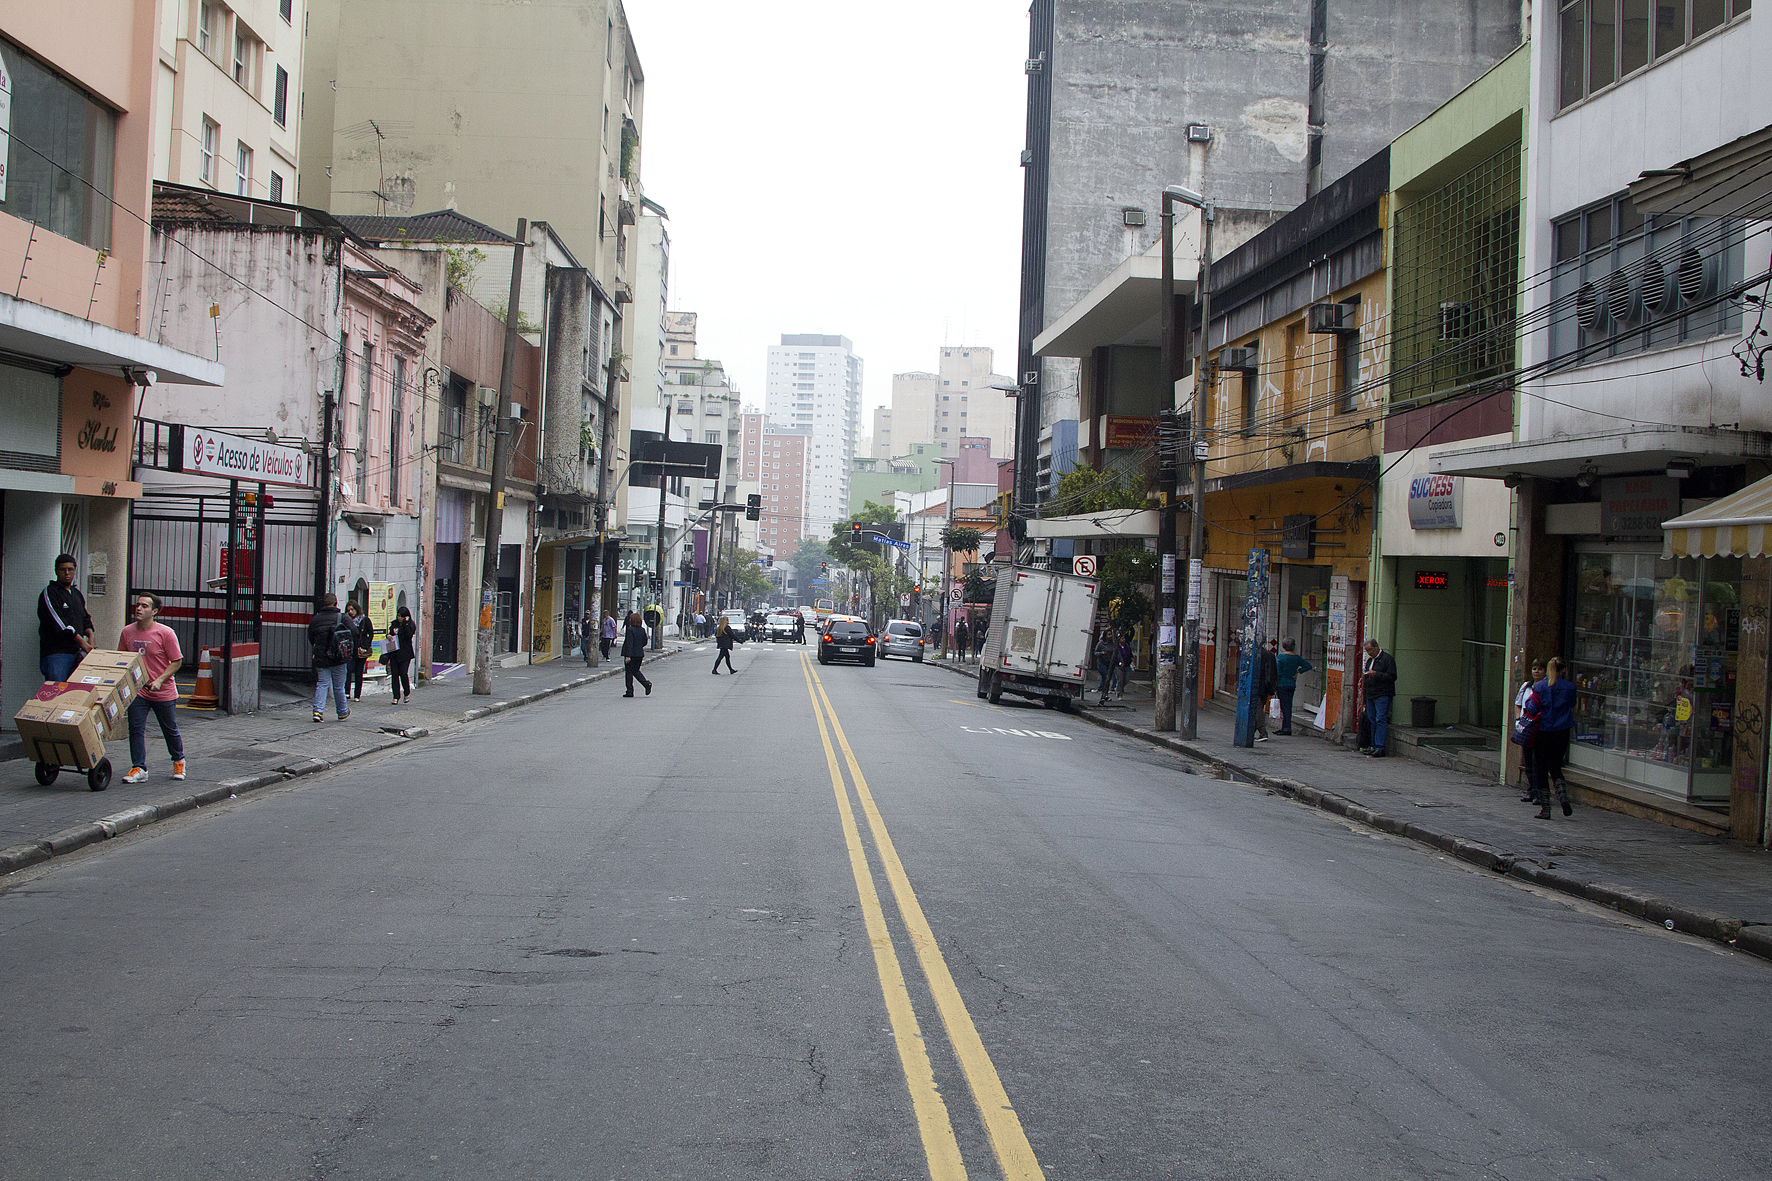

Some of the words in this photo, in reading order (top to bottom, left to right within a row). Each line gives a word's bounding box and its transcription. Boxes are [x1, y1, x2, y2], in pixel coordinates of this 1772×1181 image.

[216, 441, 248, 471] Acesso
[249, 446, 261, 472] de
[262, 449, 293, 477] Veículos
[1410, 475, 1455, 499] SUCCESS
[1428, 498, 1453, 513] Copiadora
[1609, 497, 1669, 513] PAPELARIA
[873, 536, 893, 545] Matias
[894, 541, 910, 549] Aires
[1419, 576, 1446, 585] XEROX
